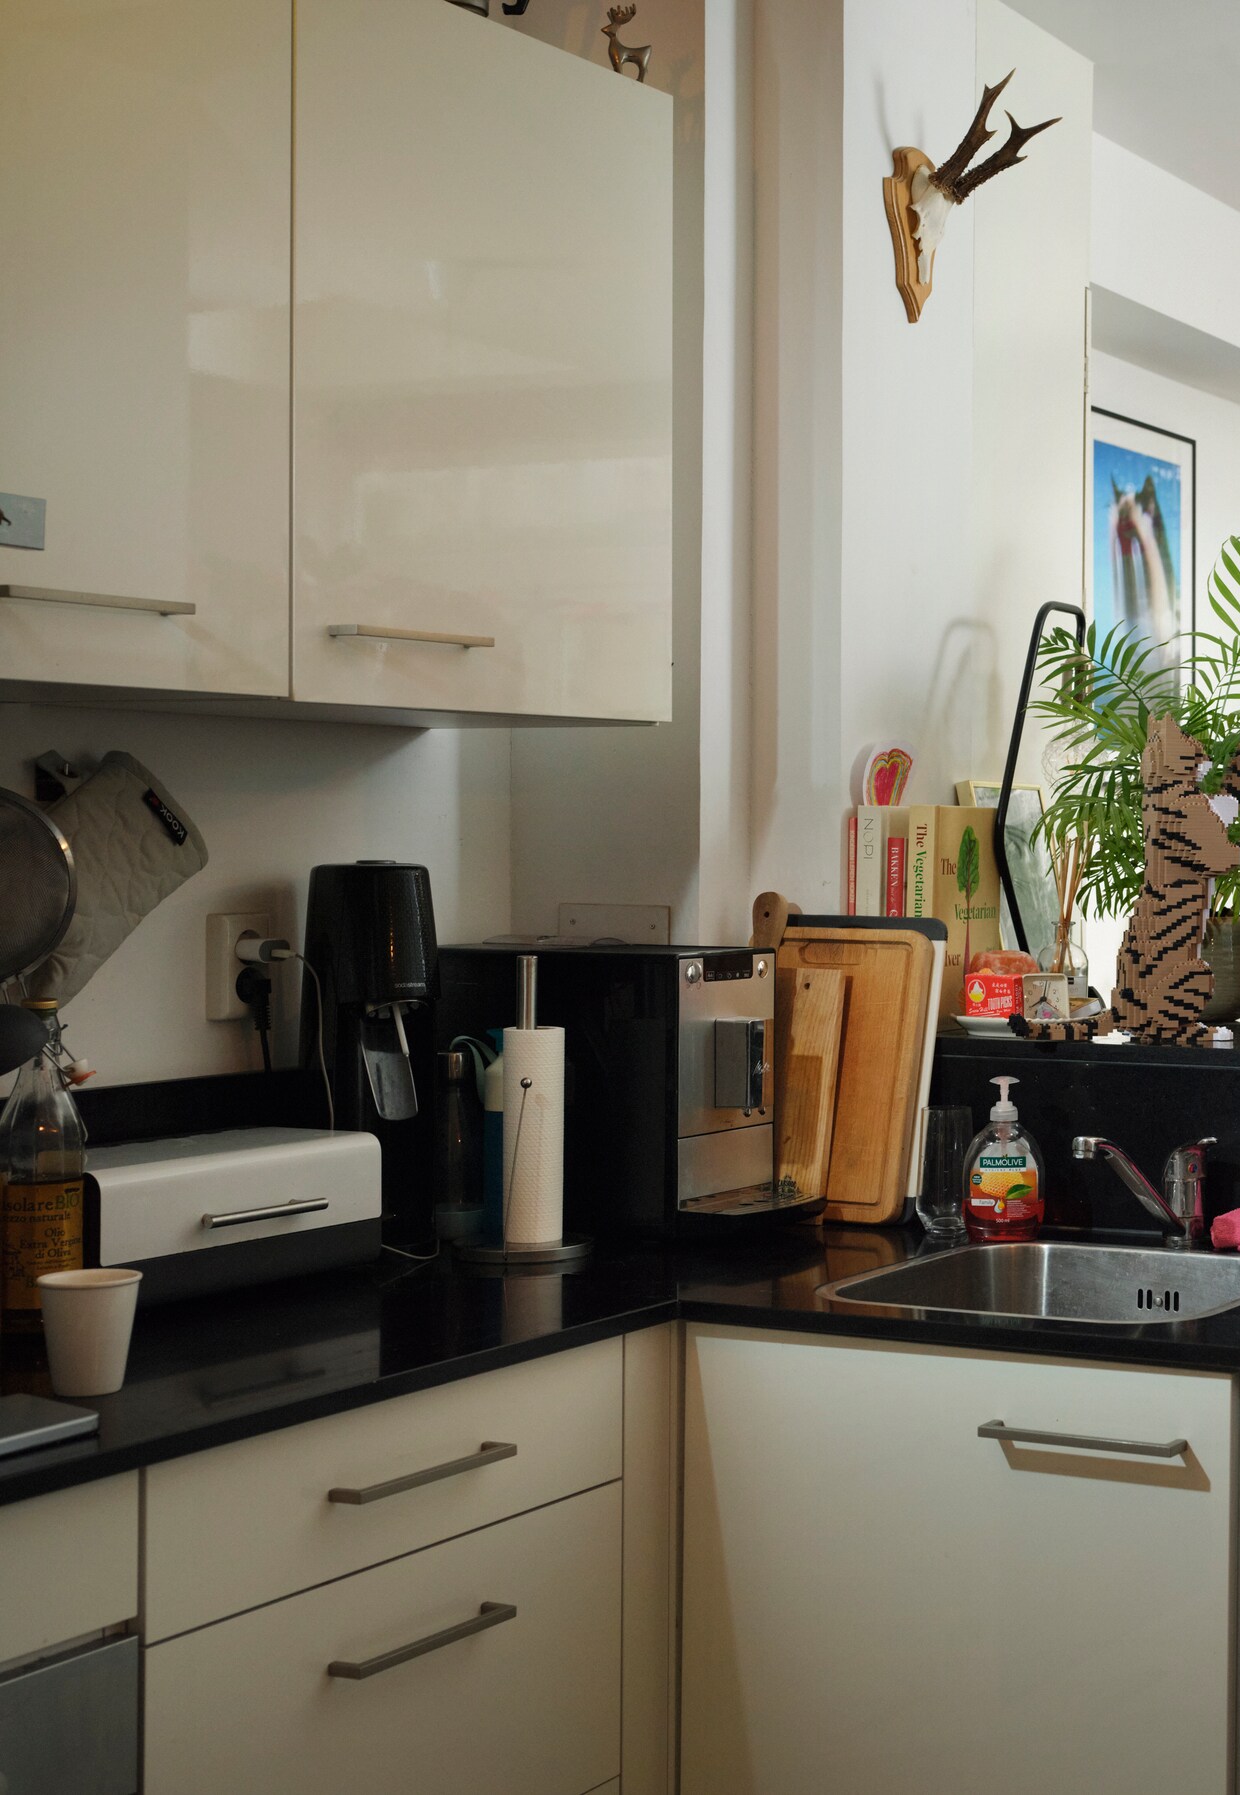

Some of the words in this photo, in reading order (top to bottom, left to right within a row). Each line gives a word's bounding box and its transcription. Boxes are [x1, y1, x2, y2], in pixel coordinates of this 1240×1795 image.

[160, 804, 185, 839] KOOK
[863, 818, 874, 860] NOPI
[916, 823, 928, 848] The
[890, 846, 899, 887] BAKKEN
[941, 858, 957, 876] The
[913, 850, 927, 918] Vegetarian
[953, 902, 997, 925] Vegetarian
[945, 950, 961, 968] lver
[982, 1158, 1024, 1167] PALMOLIVE
[44, 1227, 66, 1238] Olio
[20, 1238, 49, 1249] Extra
[34, 1248, 46, 1259] di
[47, 1247, 71, 1258] Oliva
